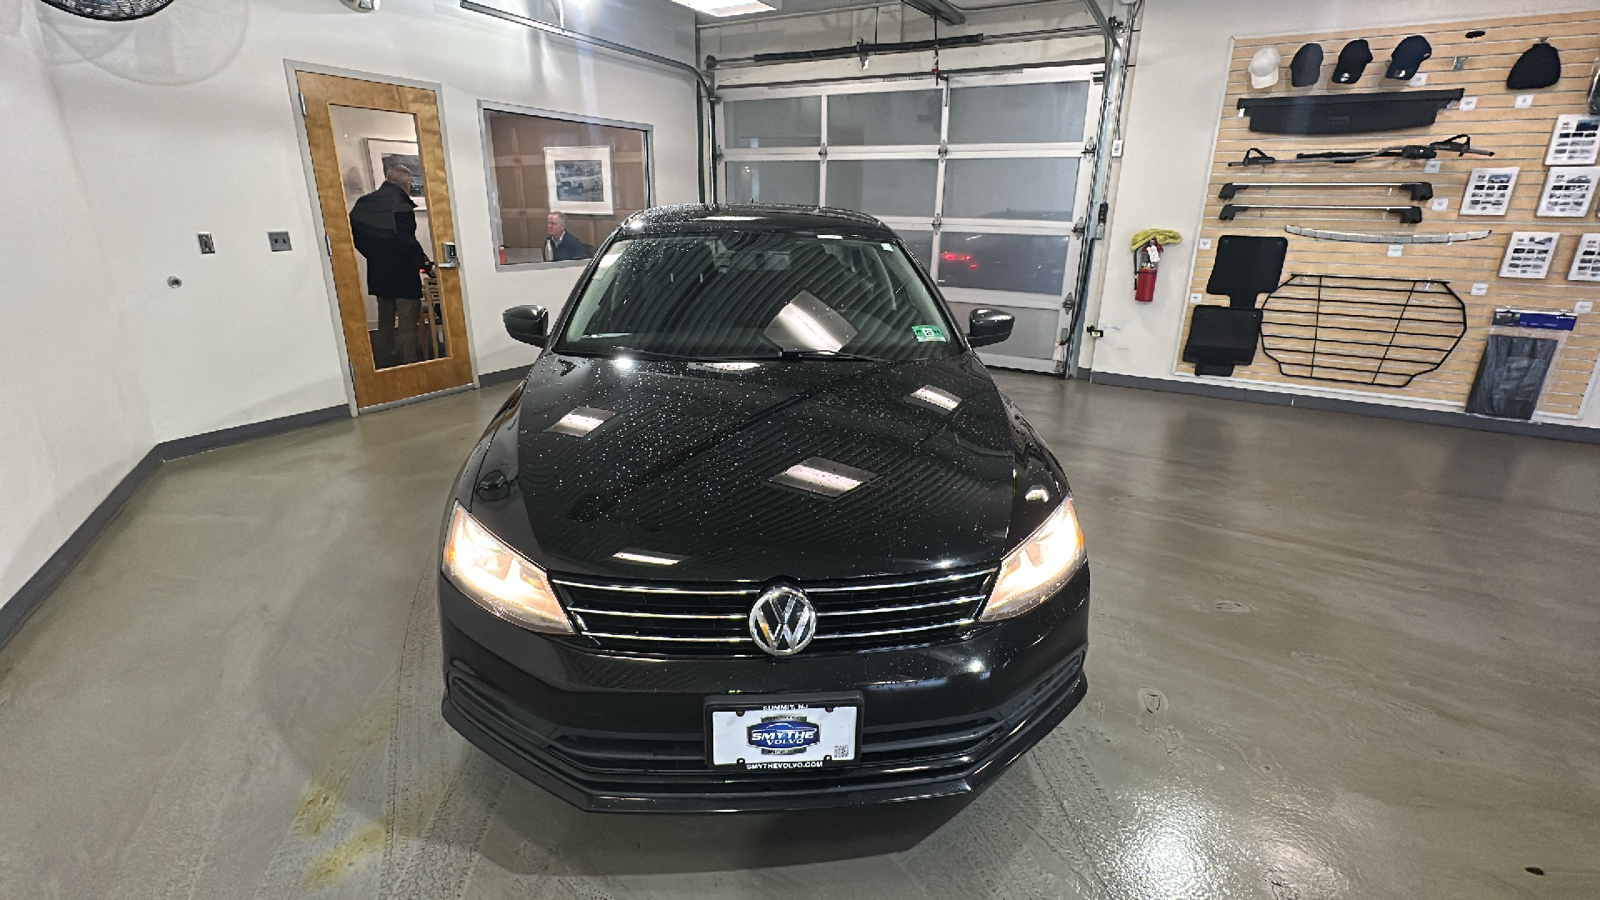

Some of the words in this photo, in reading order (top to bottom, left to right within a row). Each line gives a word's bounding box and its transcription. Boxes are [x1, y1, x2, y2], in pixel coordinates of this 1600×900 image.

[751, 730, 815, 741] SMYTHE
[766, 738, 804, 746] VOLVO
[746, 761, 823, 770] SMYTHEVOLVO.COM
